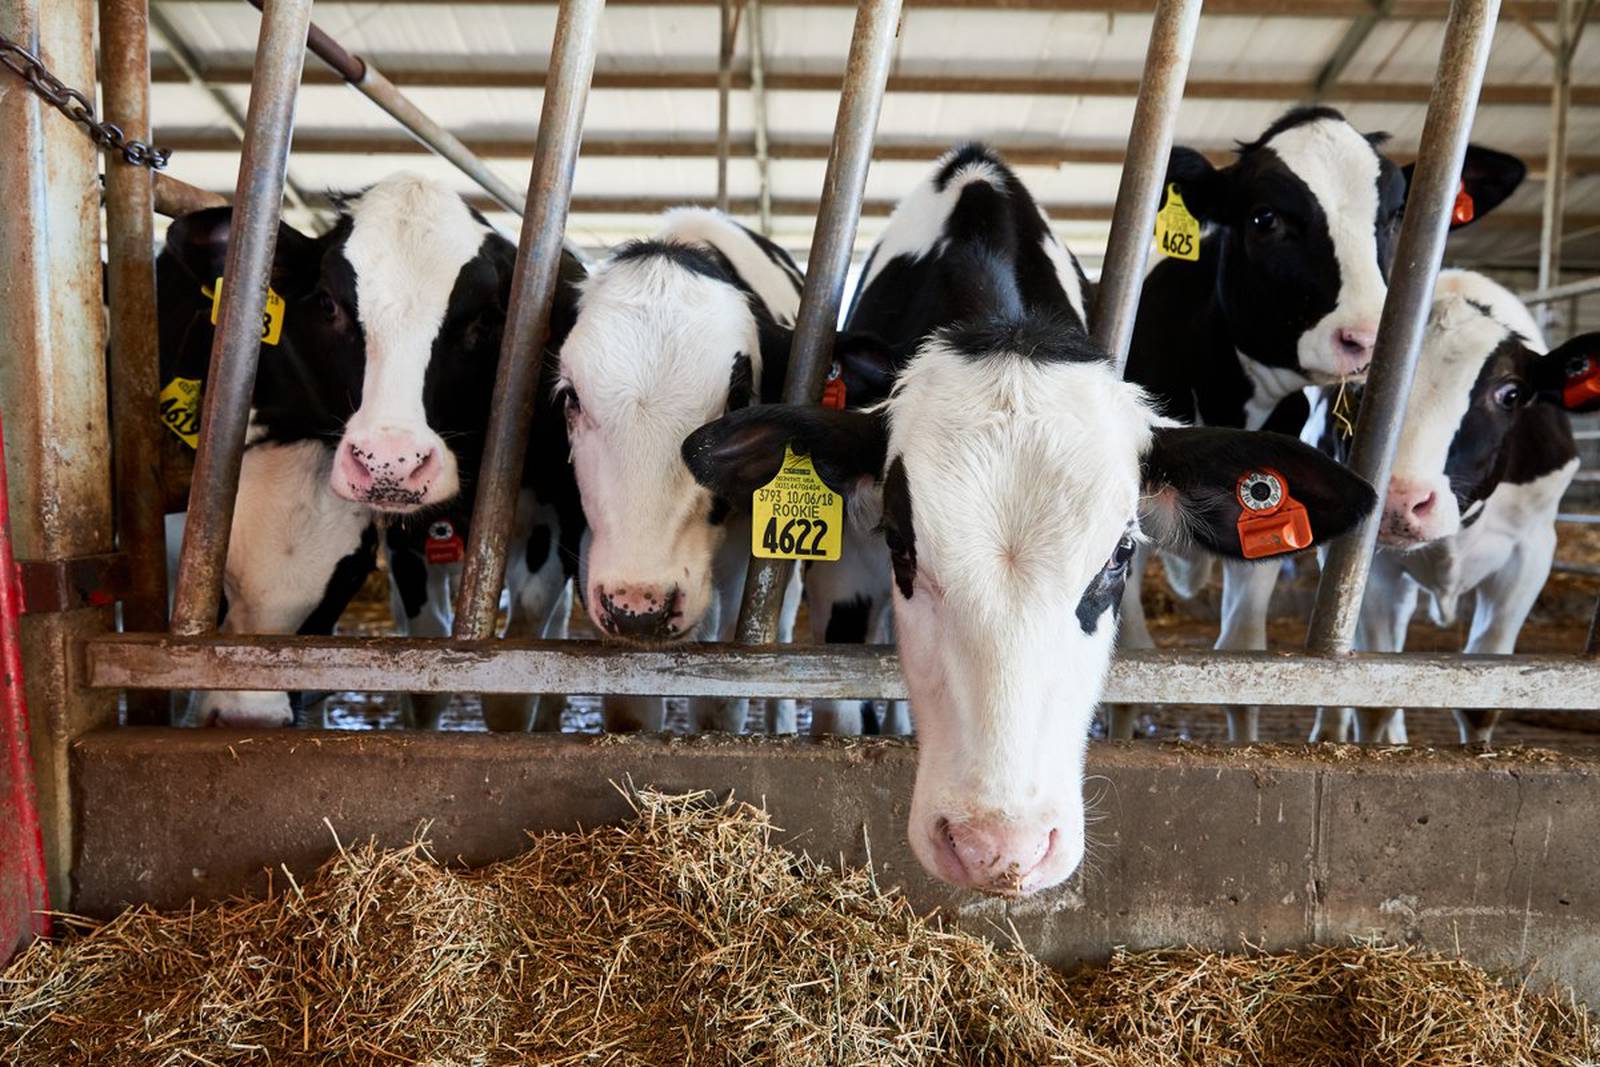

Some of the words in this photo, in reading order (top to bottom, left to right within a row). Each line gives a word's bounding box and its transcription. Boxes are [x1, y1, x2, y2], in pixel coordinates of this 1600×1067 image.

[1162, 230, 1193, 255] 4625
[759, 489, 782, 503] 3793
[787, 491, 834, 506] 10/06/18
[772, 503, 820, 519] ROOKIE
[762, 517, 828, 556] 4622
